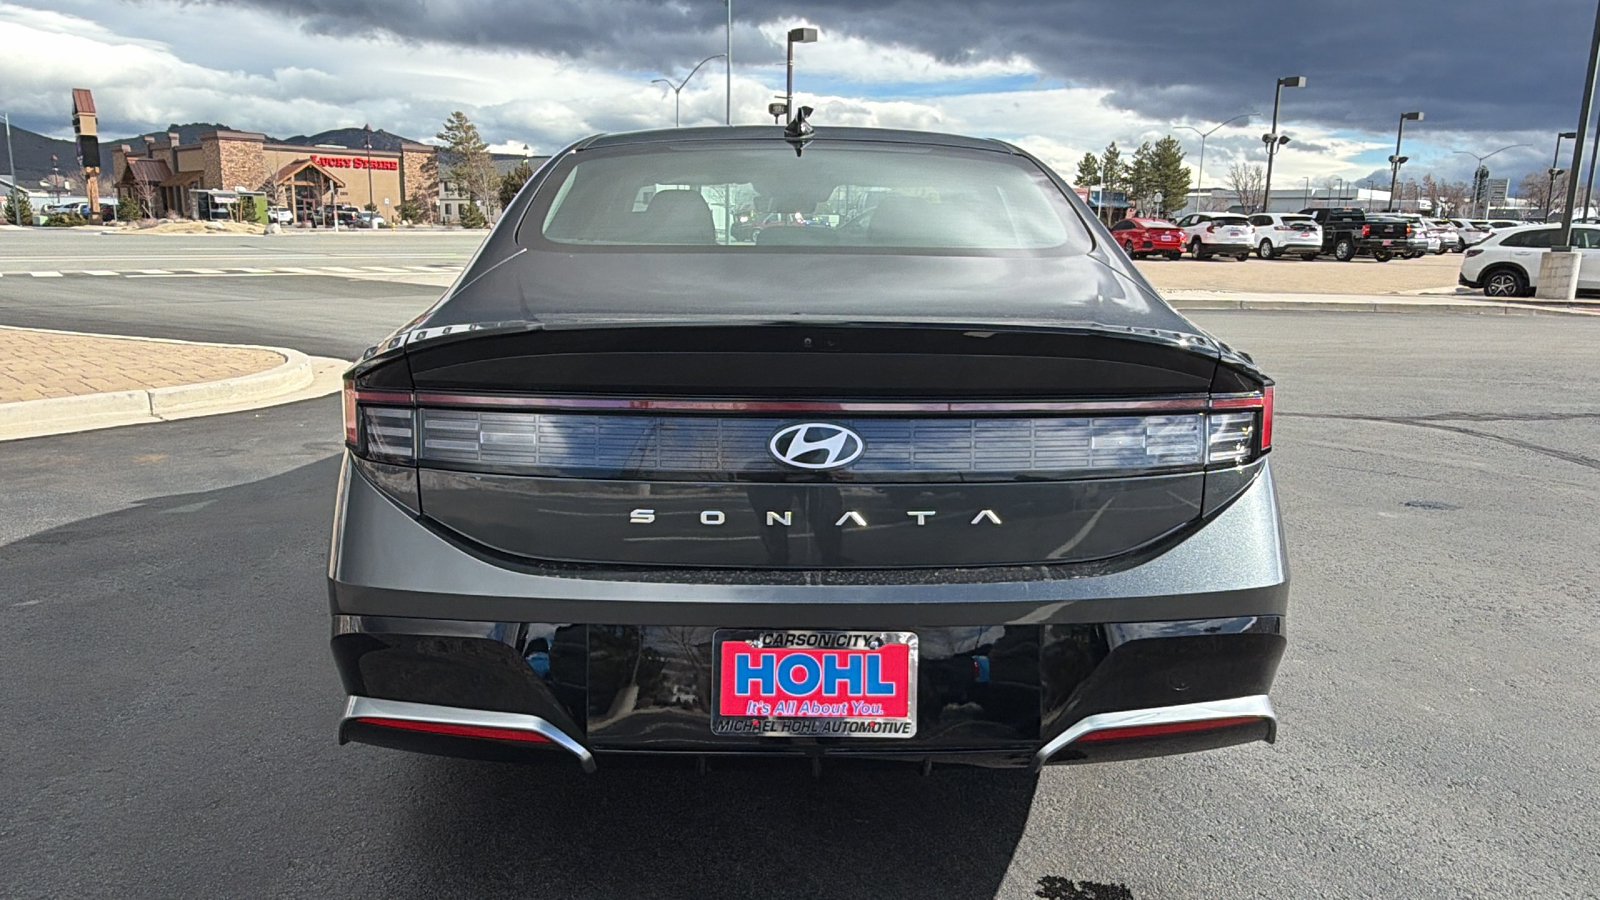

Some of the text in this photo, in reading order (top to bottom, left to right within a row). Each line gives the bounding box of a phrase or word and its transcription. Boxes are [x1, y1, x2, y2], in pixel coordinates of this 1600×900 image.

[310, 155, 398, 170] LUCKY STRIKE
[629, 508, 1003, 527] SONATA
[762, 633, 874, 647] CARSON CITY
[734, 653, 895, 696] HOHL
[746, 700, 884, 714] It's All About You.
[716, 719, 912, 734] MICHAEL HOHL AUTOMOTIVE
